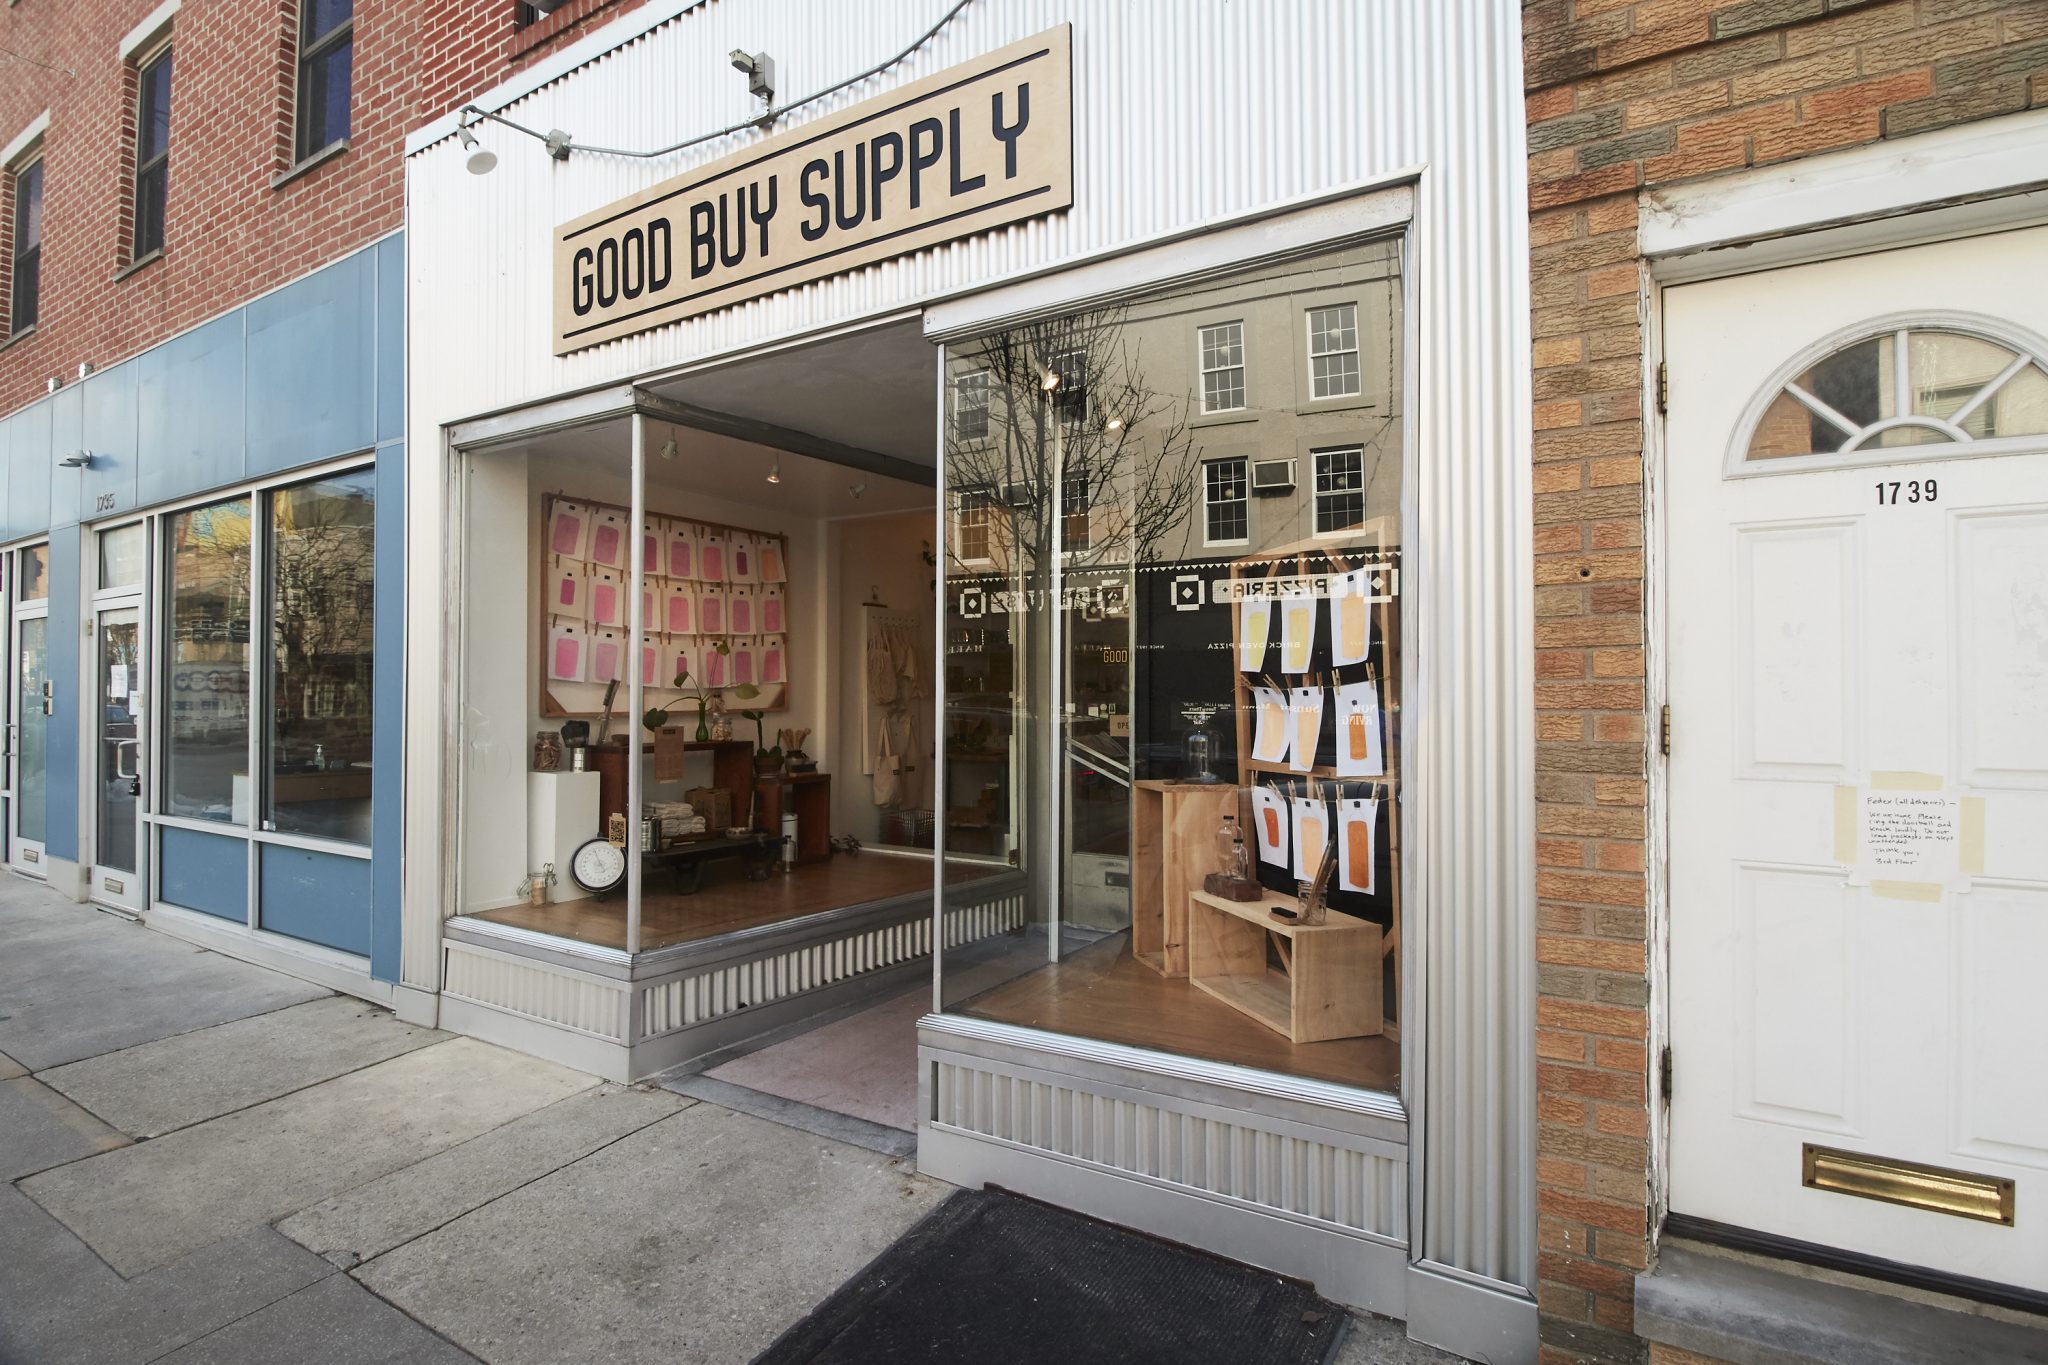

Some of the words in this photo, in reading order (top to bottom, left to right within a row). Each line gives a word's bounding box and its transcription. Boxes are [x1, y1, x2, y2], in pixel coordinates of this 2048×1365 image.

[573, 217, 672, 317] GOOD
[690, 174, 777, 280] BUY
[800, 82, 1029, 242] SUPPLY
[1875, 479, 1938, 505] 1739
[1103, 650, 1128, 662] GOOD
